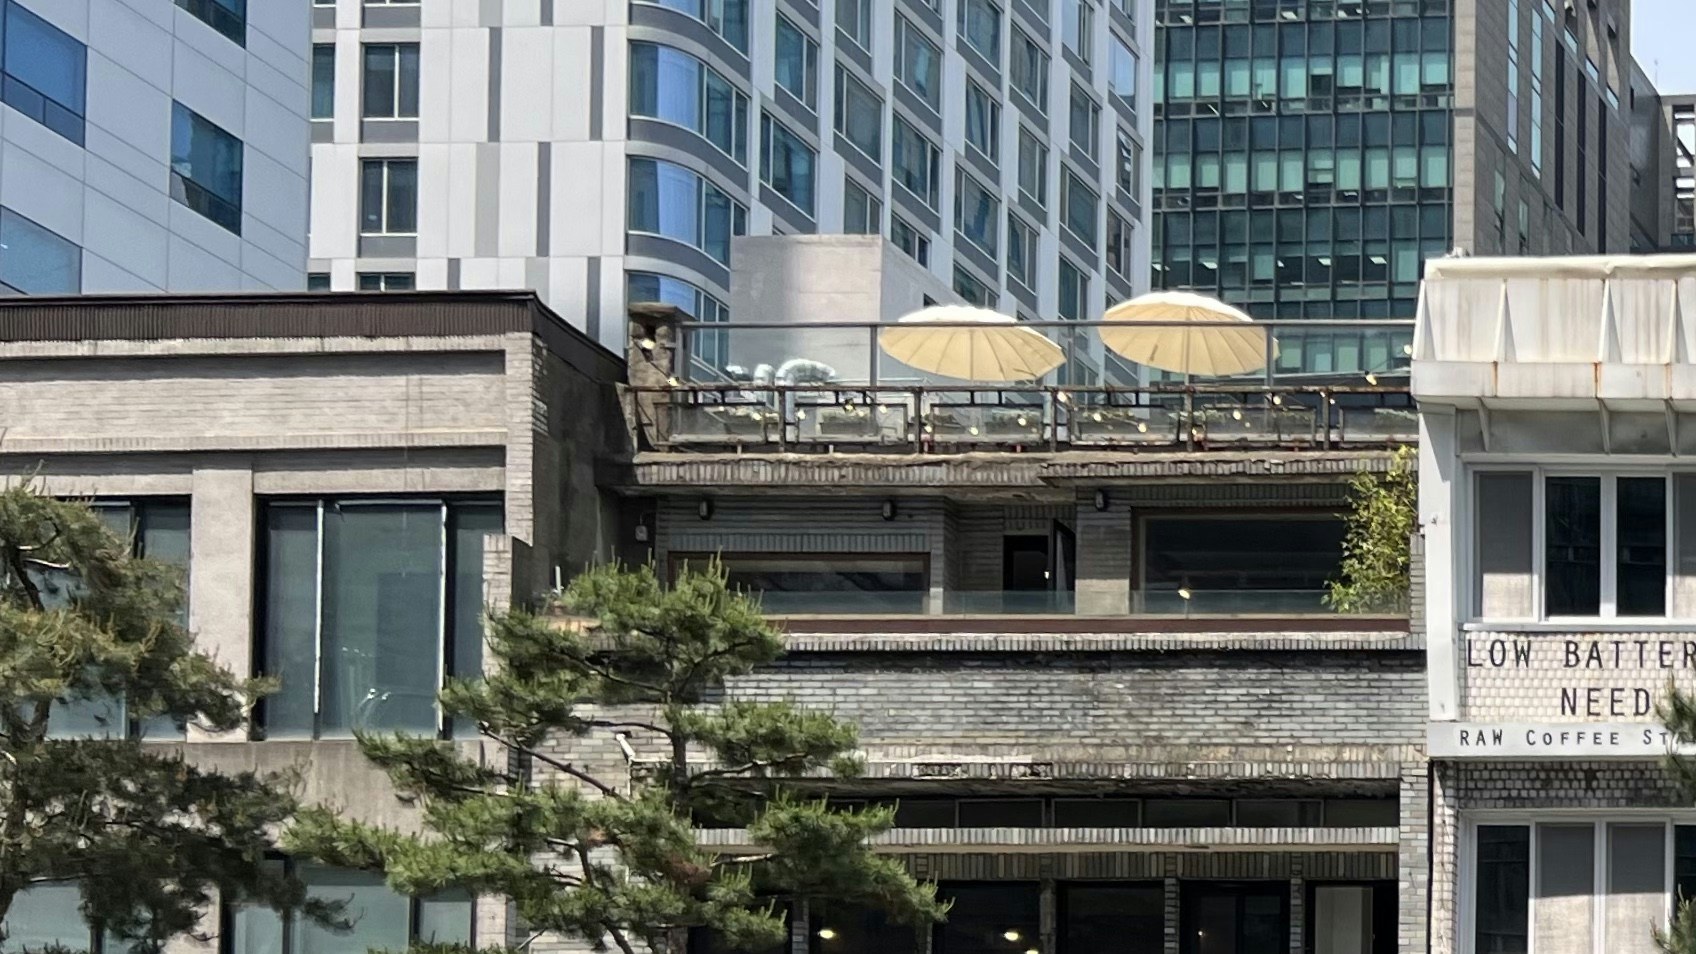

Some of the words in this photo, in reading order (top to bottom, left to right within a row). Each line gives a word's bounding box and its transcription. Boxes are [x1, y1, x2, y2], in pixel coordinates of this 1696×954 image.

[1467, 640, 1531, 667] LOW
[1561, 687, 1651, 716] NEED
[1460, 730, 1503, 746] RAW
[1526, 730, 1620, 746] COFFEE
